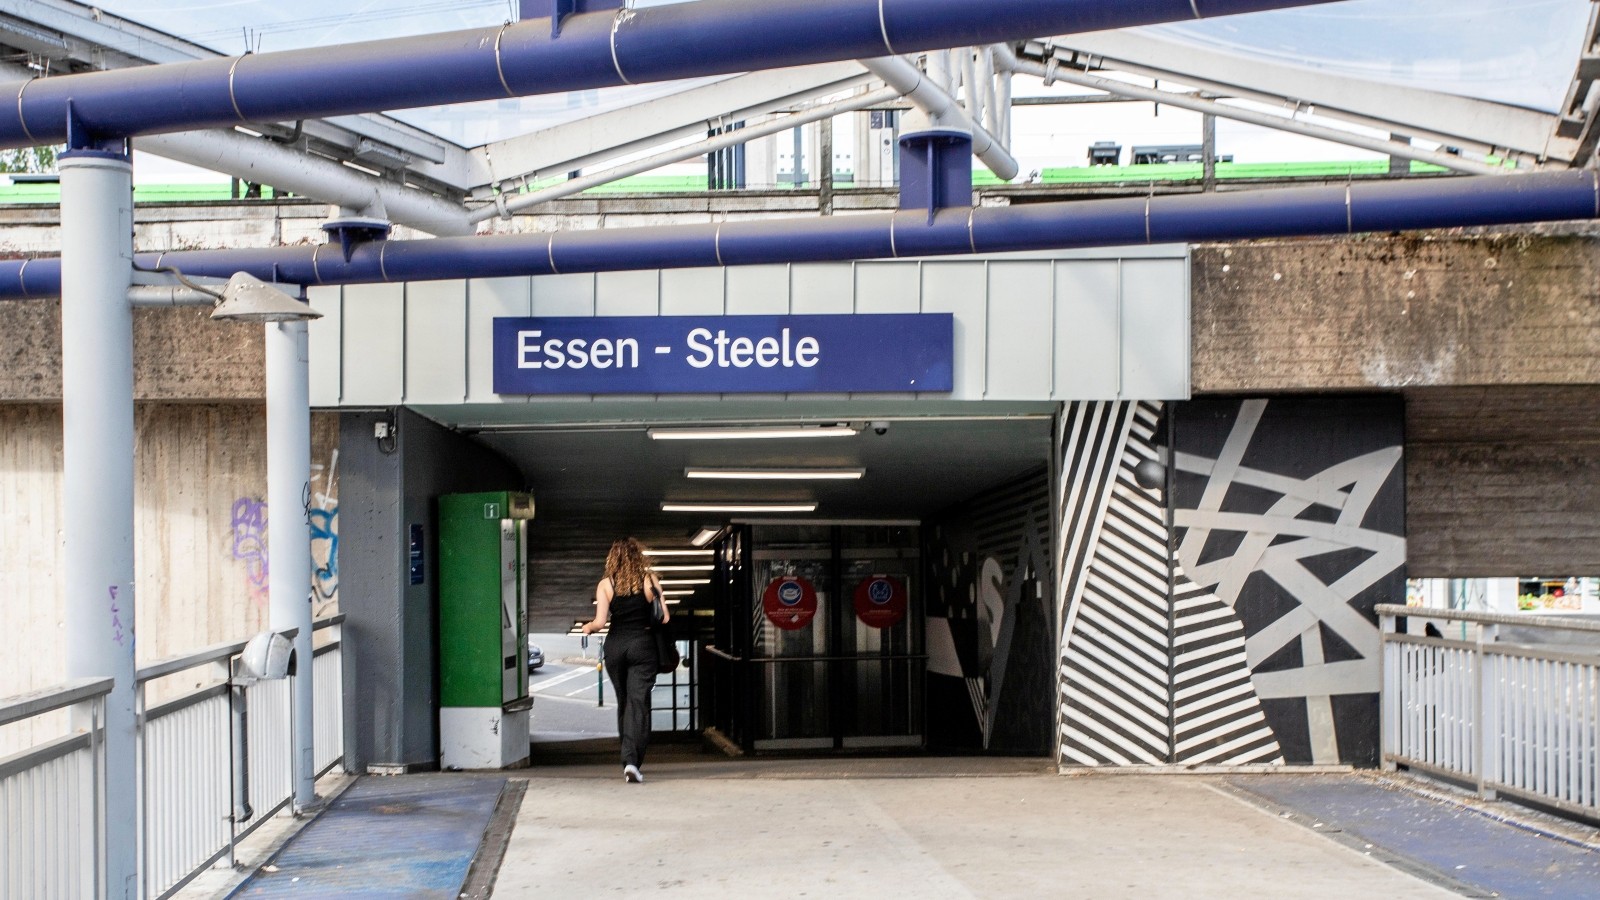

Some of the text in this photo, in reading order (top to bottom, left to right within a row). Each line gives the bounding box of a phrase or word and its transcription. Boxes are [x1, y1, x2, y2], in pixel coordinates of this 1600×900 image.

[517, 328, 820, 369] Essen - Steele
